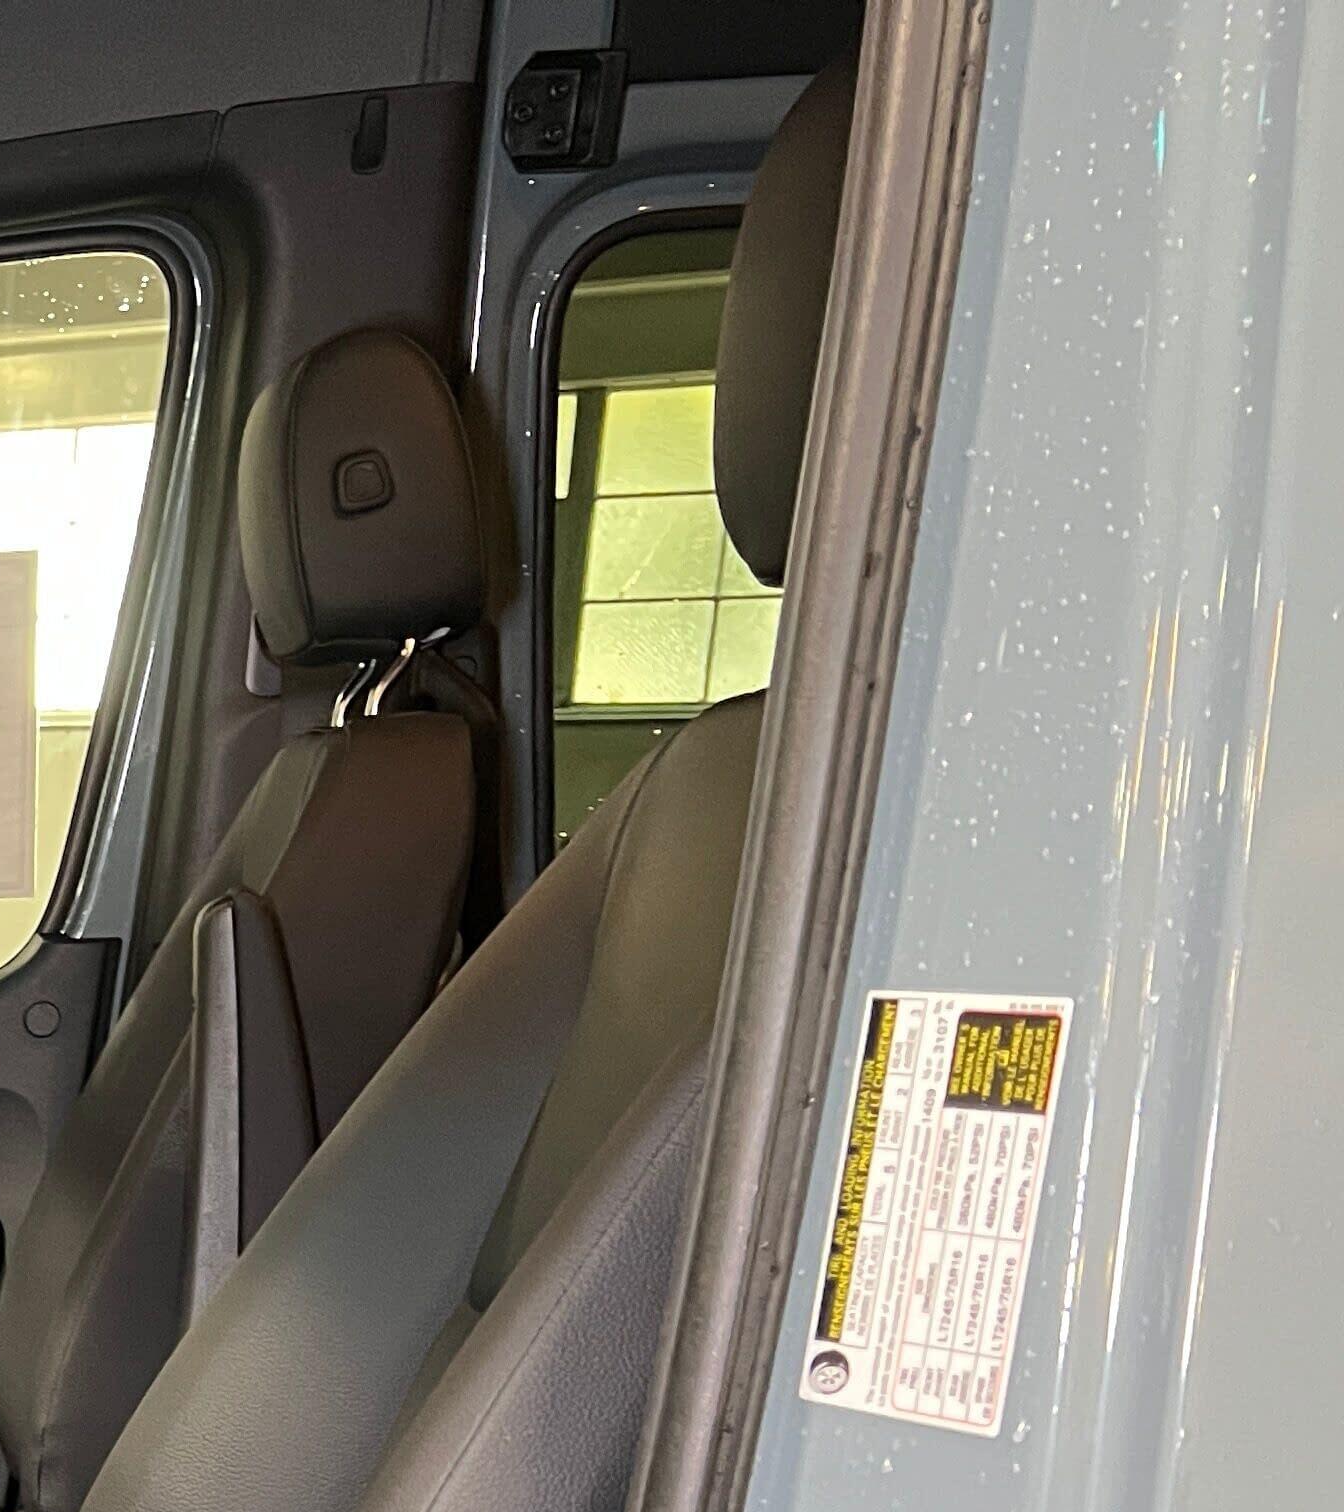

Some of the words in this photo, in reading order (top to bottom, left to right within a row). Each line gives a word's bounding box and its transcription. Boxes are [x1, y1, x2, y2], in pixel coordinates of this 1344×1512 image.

[871, 1002, 897, 1088] CHARGEMENT
[932, 1017, 950, 1053] 3107
[849, 1058, 876, 1146] INFORMATION
[868, 1093, 881, 1107] LE
[864, 1110, 878, 1127] ET
[857, 1130, 875, 1171] PNEUS
[839, 1152, 859, 1210] LOADING
[852, 1174, 867, 1199] LES
[833, 1216, 848, 1245] AND
[847, 1201, 862, 1226] SUR
[828, 1229, 858, 1339] RENSEIGNEMENTS
